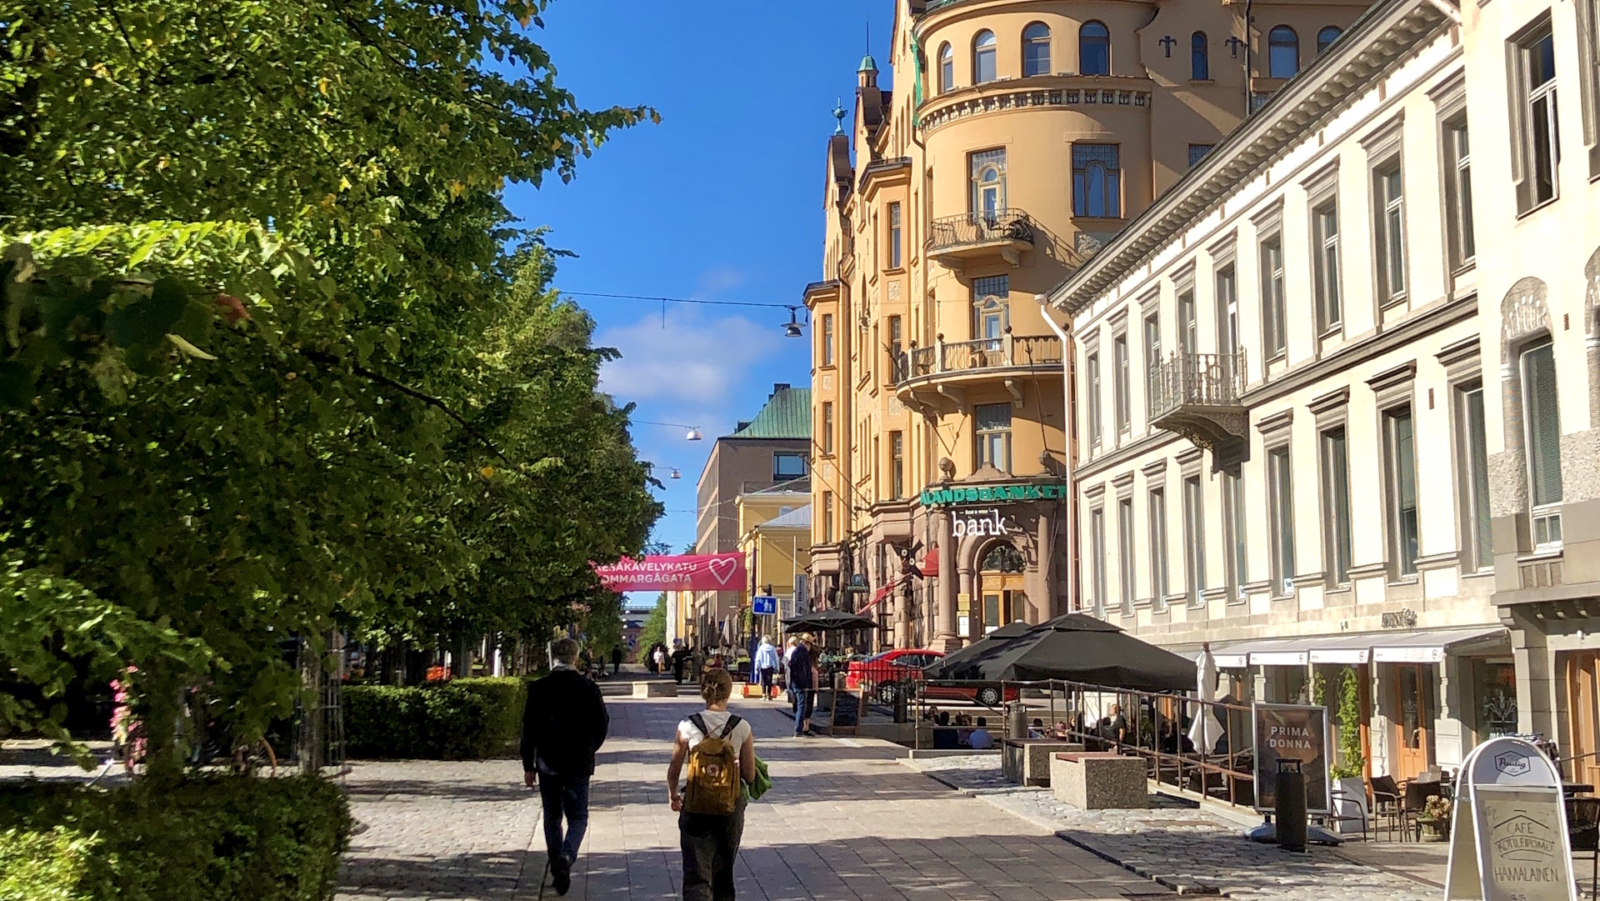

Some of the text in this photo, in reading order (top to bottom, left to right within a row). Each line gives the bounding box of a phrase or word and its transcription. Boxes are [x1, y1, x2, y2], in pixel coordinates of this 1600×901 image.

[952, 508, 1008, 537] bank
[600, 572, 692, 583] OMMARGÅGATA
[1270, 726, 1310, 737] PRIMA
[1269, 738, 1312, 749] DONNA
